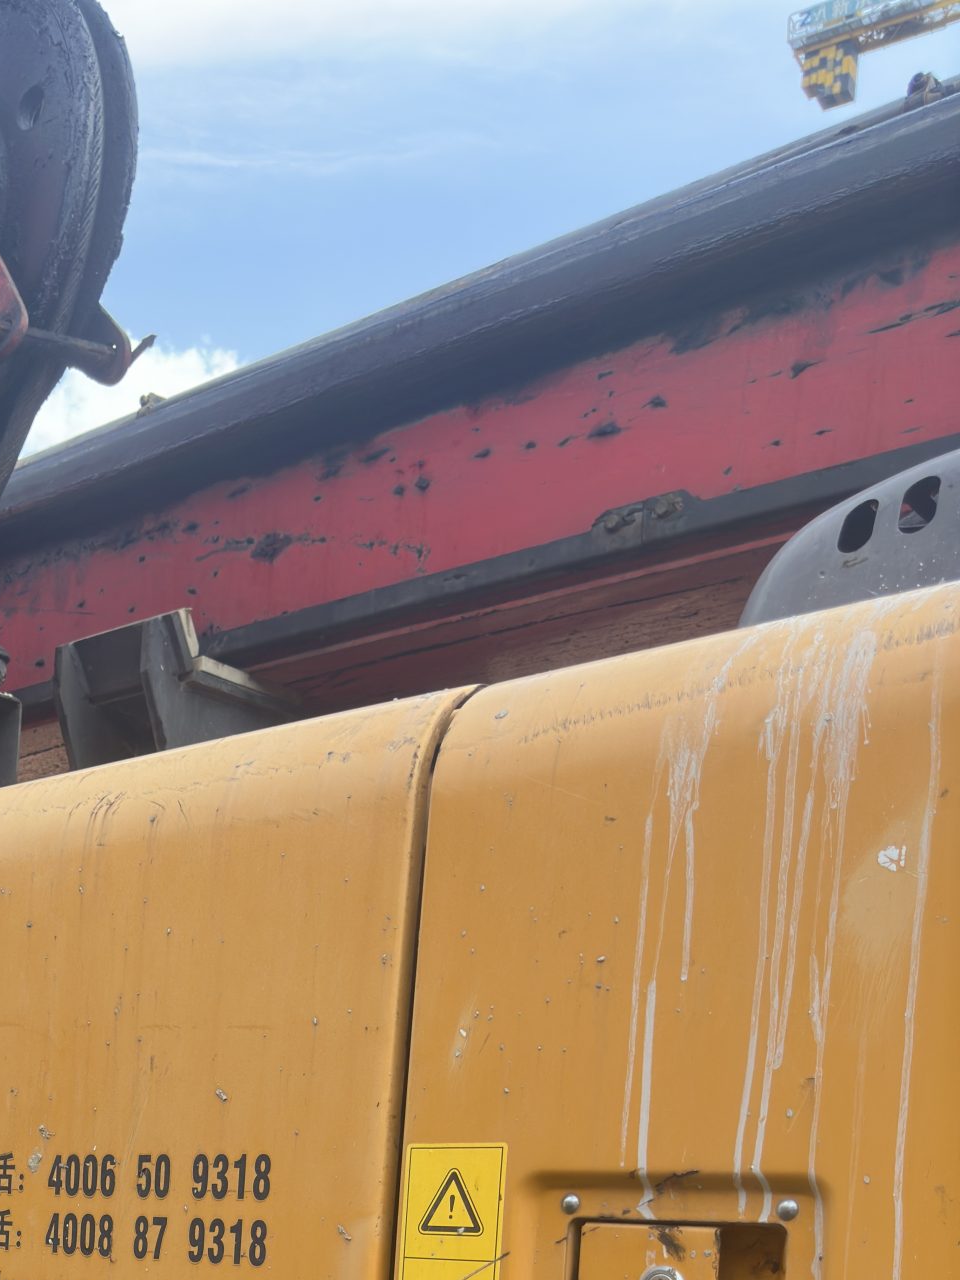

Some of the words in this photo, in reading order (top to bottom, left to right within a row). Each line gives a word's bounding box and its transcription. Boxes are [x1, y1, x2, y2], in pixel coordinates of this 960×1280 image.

[47, 1153, 116, 1197] 4006
[136, 1153, 171, 1199] 50
[192, 1153, 272, 1201] 9318
[45, 1212, 113, 1258] 4008
[133, 1215, 168, 1260] 87
[188, 1216, 267, 1267] 9318
